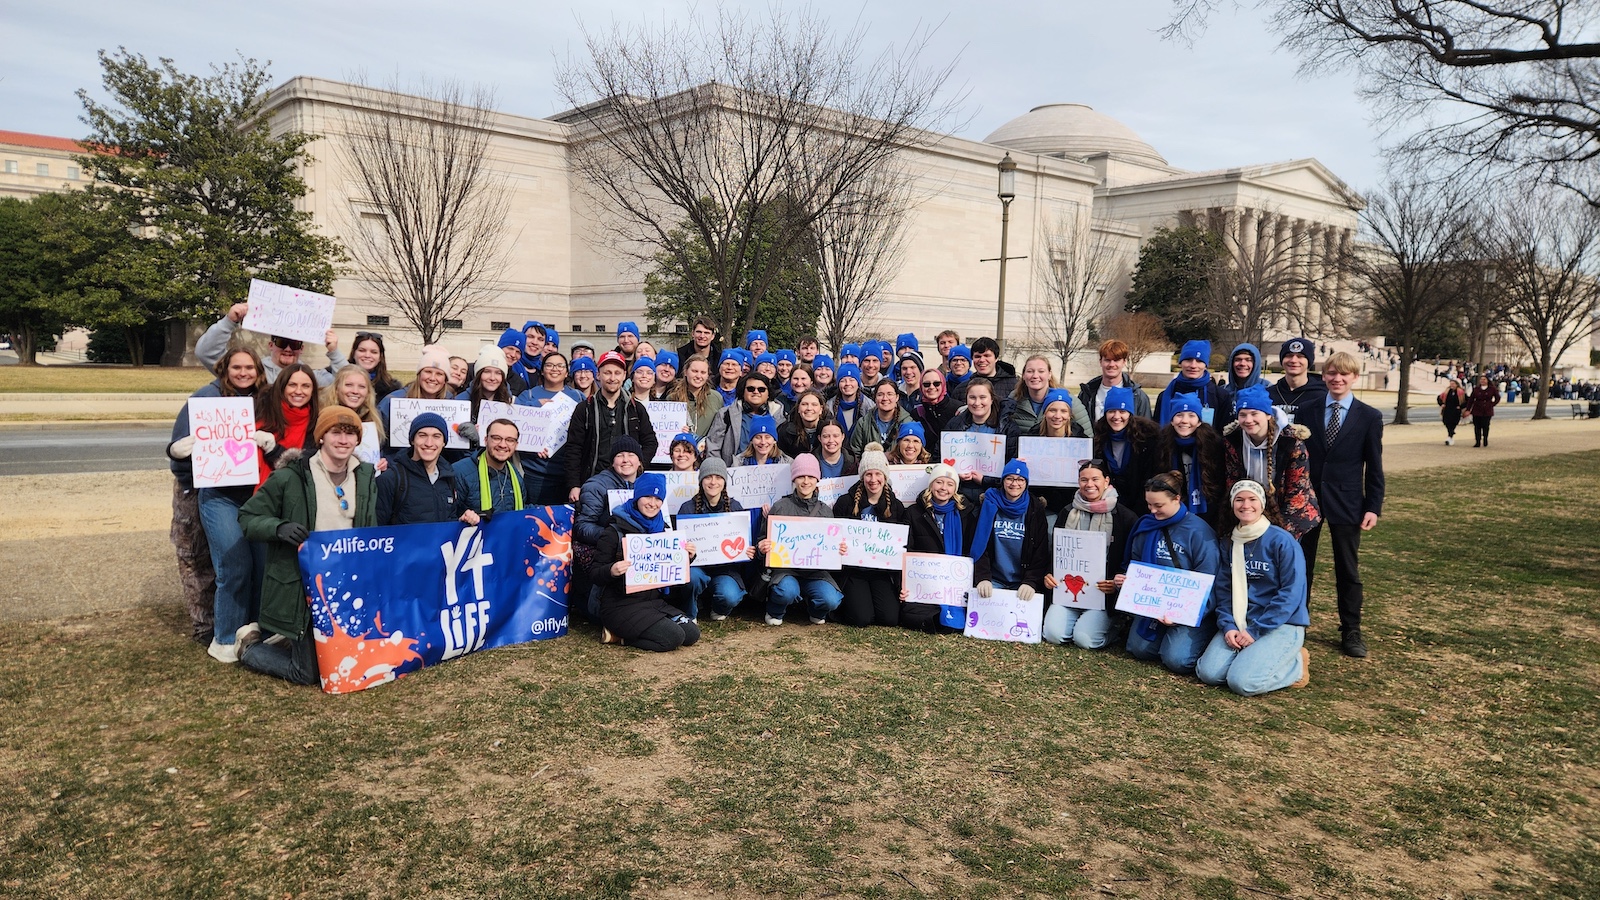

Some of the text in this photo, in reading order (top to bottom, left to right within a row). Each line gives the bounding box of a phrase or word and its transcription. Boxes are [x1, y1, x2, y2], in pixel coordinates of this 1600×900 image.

[241, 408, 249, 417] a
[425, 404, 457, 413] marching
[460, 404, 470, 412] for
[648, 402, 687, 412] ABORTION
[195, 423, 256, 442] CHOICE
[652, 421, 680, 430] NEVER
[518, 433, 547, 447] TION
[959, 459, 998, 474] Called!
[666, 473, 682, 484] ERY
[727, 469, 753, 487] Your
[741, 485, 777, 495] Matters
[819, 479, 845, 492] reated
[819, 492, 842, 501] hosen
[774, 523, 824, 549] Pregnancy
[847, 525, 893, 542] every life
[321, 537, 394, 560] y4life.org
[822, 543, 829, 551] is
[852, 537, 860, 547] is
[1056, 534, 1083, 550] LITTLE
[1171, 542, 1185, 554] IFE
[653, 552, 672, 561] MOM
[792, 547, 823, 566] Gift
[1056, 547, 1075, 559] MISS
[440, 526, 494, 605] Y4
[635, 562, 682, 582] CHOSE LIFE
[1056, 557, 1091, 573] PRO-LIFE
[1250, 560, 1270, 572] LIFE
[1158, 573, 1201, 589] ABORTION
[914, 583, 966, 606] love ME
[1141, 584, 1182, 596] does NOT
[1133, 592, 1162, 606] DEFINE
[982, 612, 1006, 628] God
